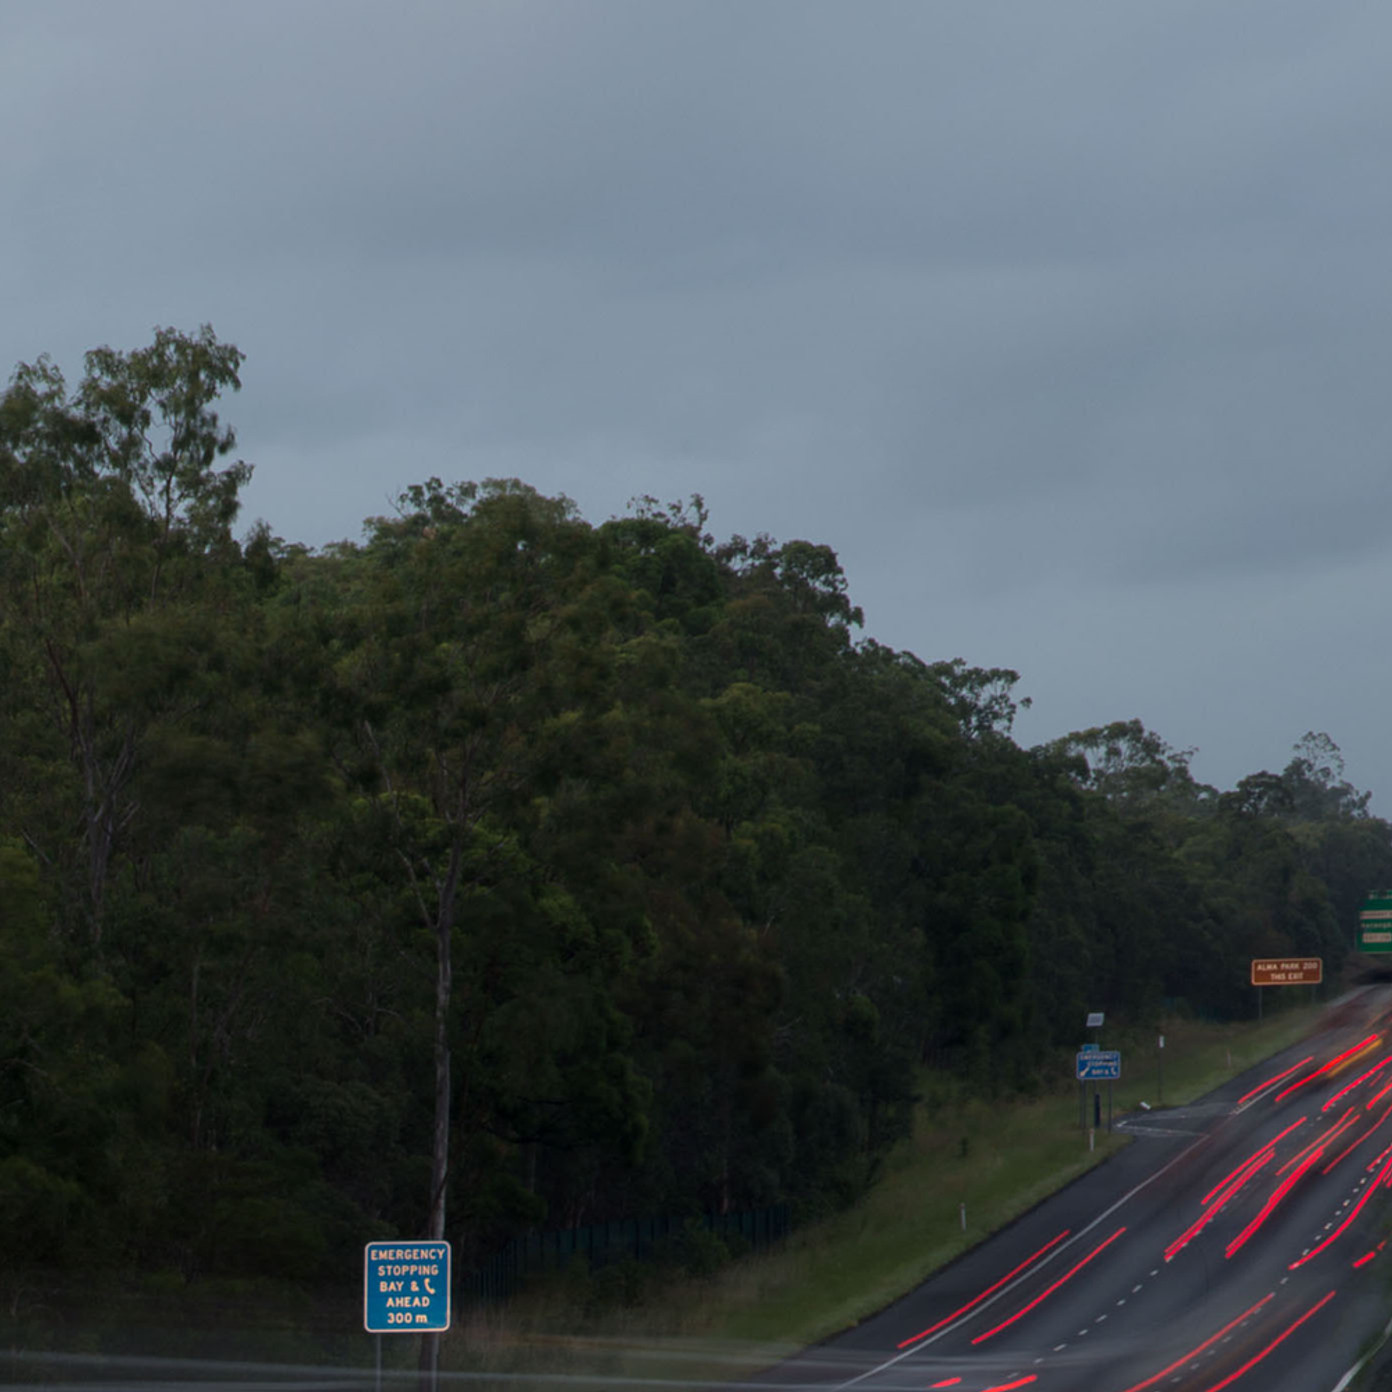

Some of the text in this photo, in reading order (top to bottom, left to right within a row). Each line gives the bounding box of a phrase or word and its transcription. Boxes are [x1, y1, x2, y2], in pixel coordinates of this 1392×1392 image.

[370, 1248, 446, 1261] EMERGENCY
[377, 1264, 439, 1277] STOPPING
[379, 1280, 420, 1293] BAY &
[386, 1296, 430, 1308] AHEAD
[387, 1312, 413, 1324] 300
